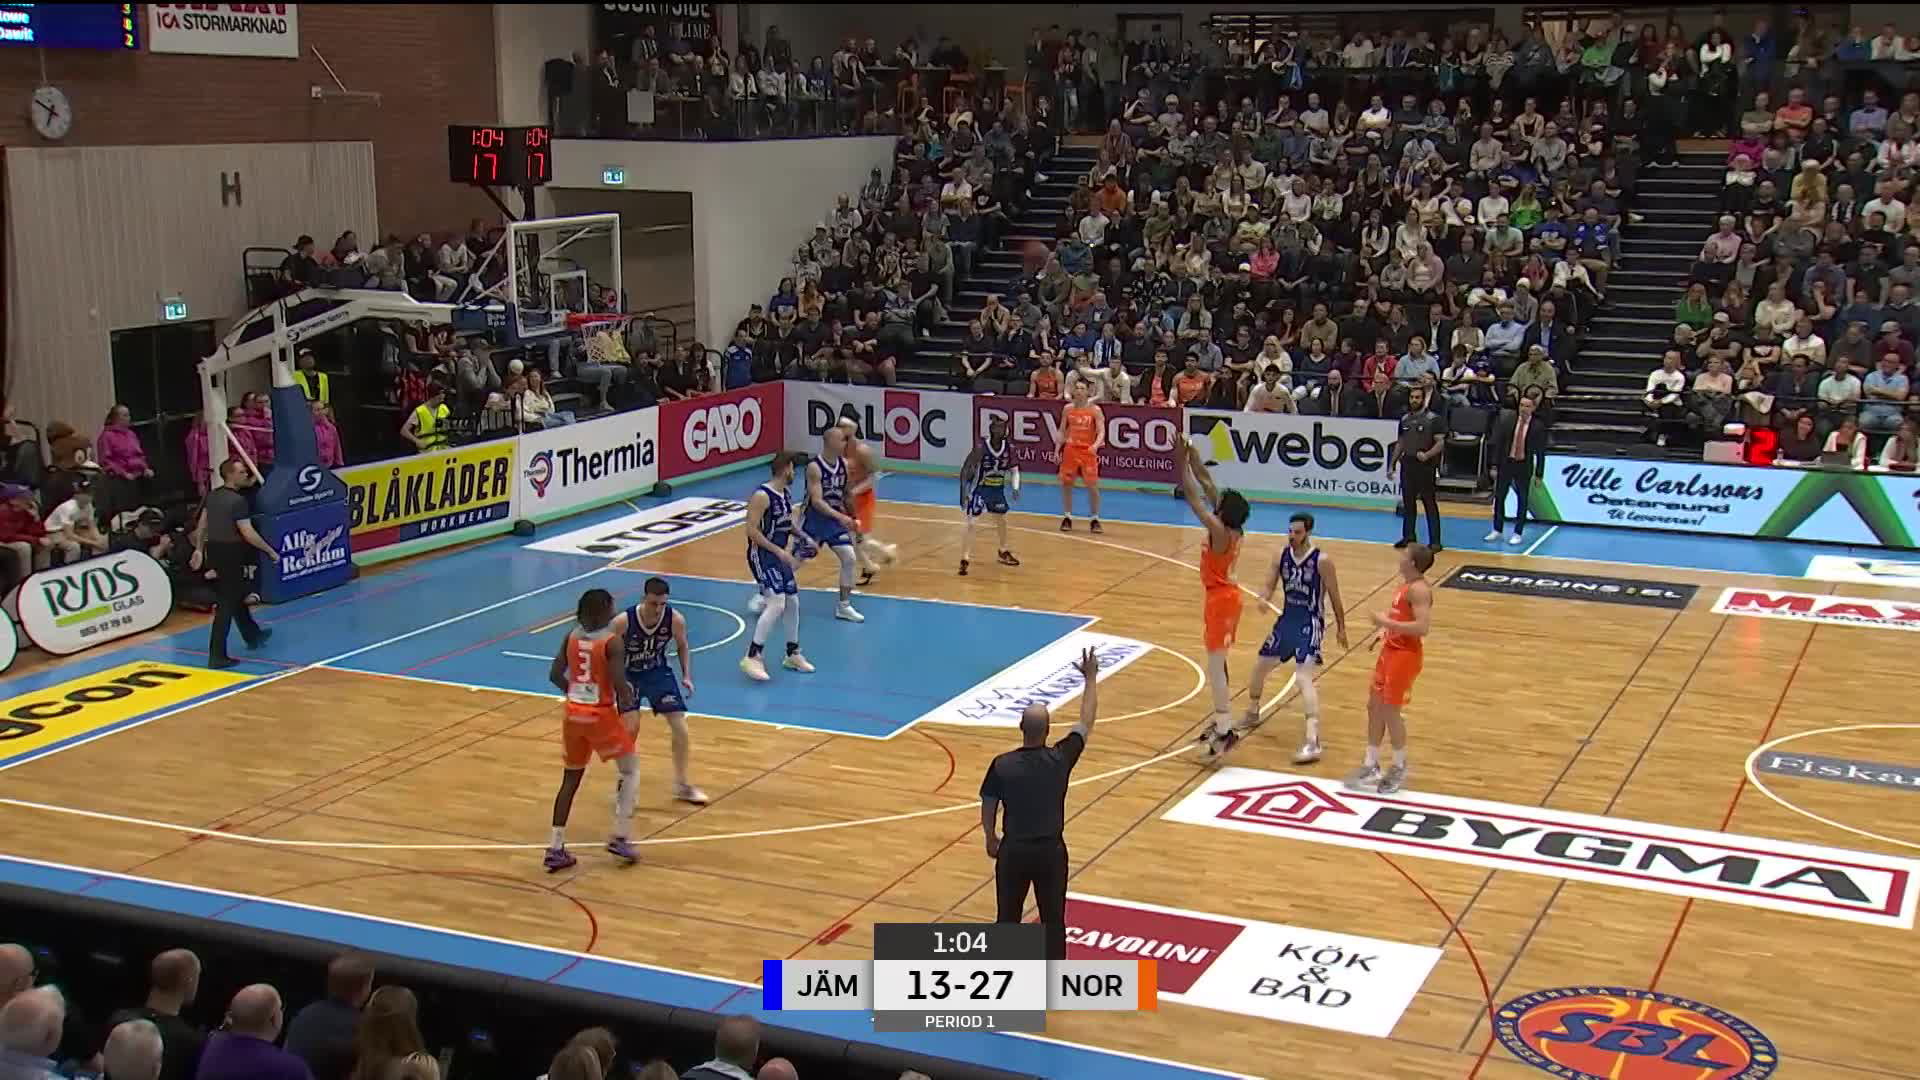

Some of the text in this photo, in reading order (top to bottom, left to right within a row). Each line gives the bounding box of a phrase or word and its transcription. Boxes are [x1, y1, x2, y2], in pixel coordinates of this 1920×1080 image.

[157, 12, 287, 34] ICA STORMARKNAD
[472, 128, 503, 147] 1:04
[526, 128, 548, 146] 1:04
[473, 153, 497, 180] 17
[527, 153, 544, 179] 17
[220, 171, 242, 207] H
[683, 397, 762, 462] GARO
[807, 399, 946, 448] DALOC
[557, 432, 654, 487] Thermia
[1231, 421, 1400, 473] weber
[1116, 457, 1173, 471] ISOLERING
[349, 456, 509, 529] BLÅKLÄDER
[1561, 463, 1764, 500] Ville Carlssons
[420, 506, 492, 534] WORKWEAR
[40, 560, 139, 616] RYDS
[112, 595, 144, 612] GLAS
[1359, 806, 1872, 904] BYGMA
[1277, 943, 1381, 972] KÖK
[1297, 966, 1332, 985] &
[1249, 977, 1352, 1009] BAD
[1532, 1011, 1734, 1070] SBL
